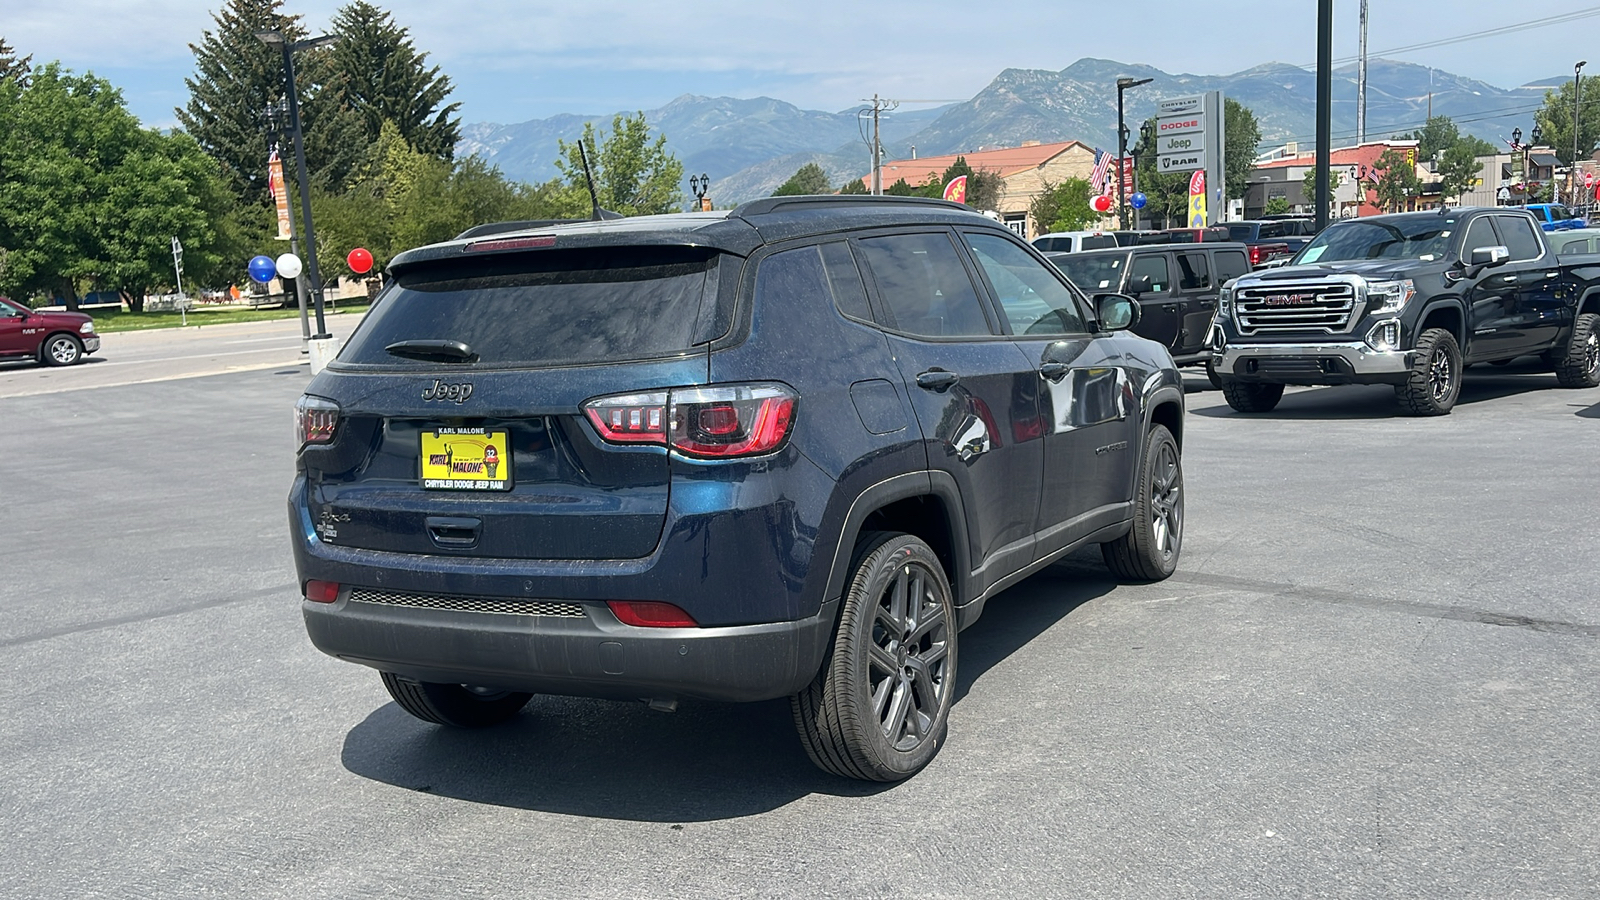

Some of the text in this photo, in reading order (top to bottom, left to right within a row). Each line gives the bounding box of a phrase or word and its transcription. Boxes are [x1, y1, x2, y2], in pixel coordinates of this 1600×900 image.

[1161, 100, 1197, 108] CHRYSLER
[1161, 120, 1198, 130] DODGE
[1167, 138, 1191, 149] Jeep
[1172, 157, 1198, 166] RAM
[1265, 293, 1315, 305] GMC
[422, 379, 473, 404] Jeep
[486, 449, 495, 458] 32
[429, 454, 448, 465] KARL
[453, 462, 483, 473] MALONE
[425, 479, 504, 489] CHRYSLER DODGE JEEP RAM
